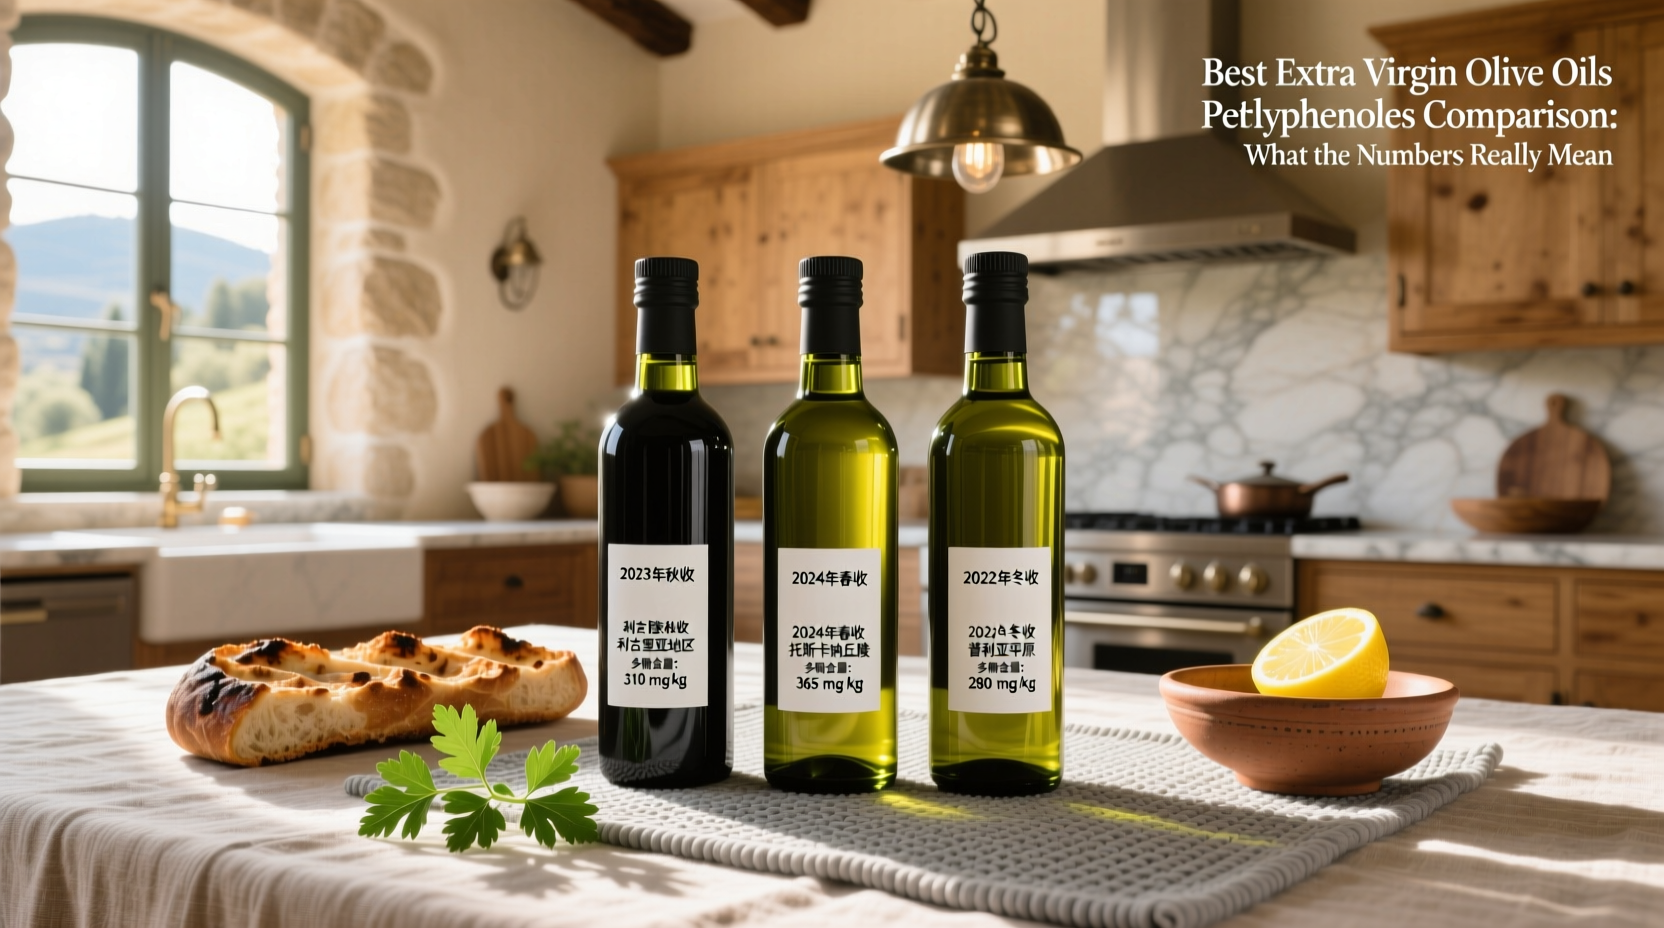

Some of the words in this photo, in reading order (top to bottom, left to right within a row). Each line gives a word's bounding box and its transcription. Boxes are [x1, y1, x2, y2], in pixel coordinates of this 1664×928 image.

[620, 566, 695, 583] 2023年秋收
[792, 570, 868, 587] 2024年春收
[963, 569, 1039, 586] 2022年冬收
[623, 673, 646, 686] 310
[796, 676, 819, 690] 365
